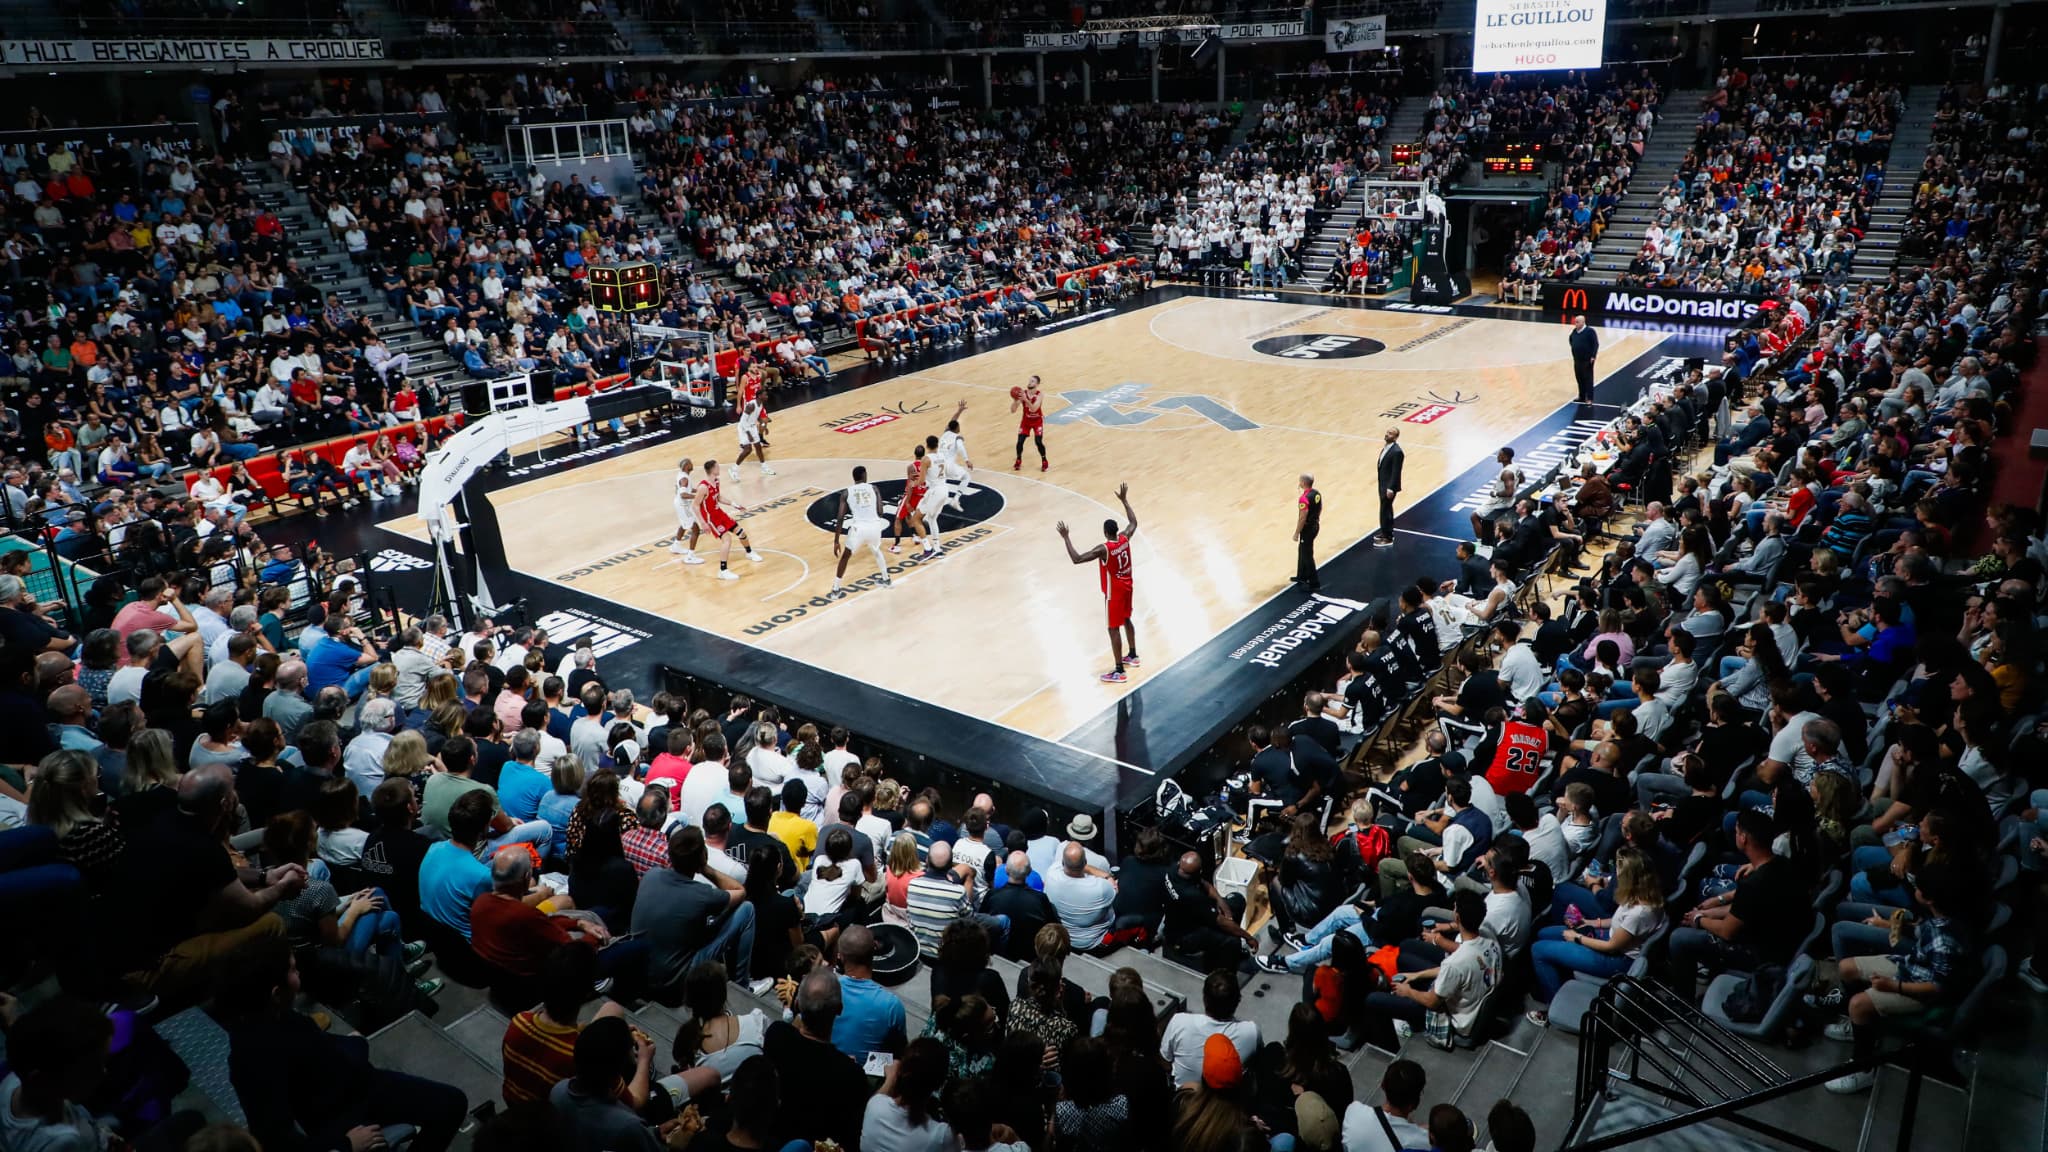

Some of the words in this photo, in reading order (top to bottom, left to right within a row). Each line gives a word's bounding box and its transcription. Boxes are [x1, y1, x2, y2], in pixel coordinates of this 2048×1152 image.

[1486, 14, 1508, 27] LE
[1511, 8, 1594, 26] GUILLOU
[1024, 35, 1054, 47] PAUL
[1231, 25, 1263, 37] POUR
[1272, 22, 1304, 36] TOUT
[92, 42, 250, 61] BERGAMOTES
[267, 41, 280, 59] A
[288, 41, 383, 59] CROQUER
[1515, 54, 1557, 65] HUGO
[1605, 292, 1759, 319] McDonald's
[1450, 419, 1611, 512] VILLEURB
[556, 549, 654, 583] THINGS
[1117, 549, 1129, 570] 13
[742, 527, 993, 637] smargoodshop.com
[1287, 600, 1320, 619] Intérim
[1228, 623, 1287, 660] Recrutement
[1250, 612, 1338, 668] Adéquat
[1505, 746, 1540, 775] 23
